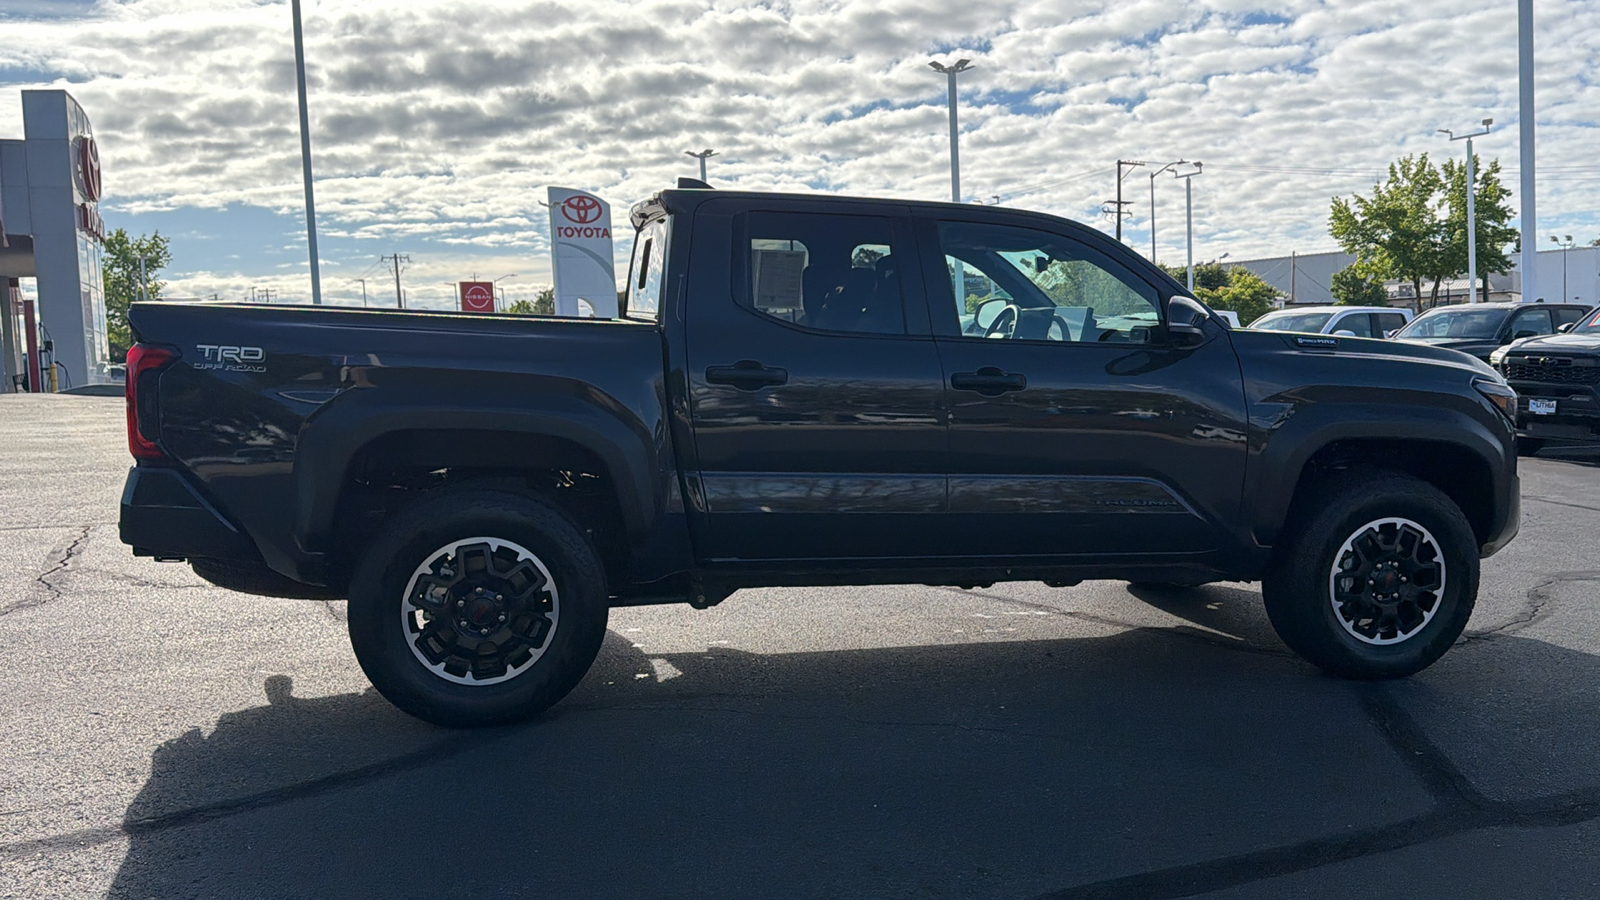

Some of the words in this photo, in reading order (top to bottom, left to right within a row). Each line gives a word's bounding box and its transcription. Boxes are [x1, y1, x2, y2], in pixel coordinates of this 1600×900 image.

[557, 226, 611, 239] TOYOTA
[196, 344, 264, 363] TRD
[225, 363, 267, 373] ROAD
